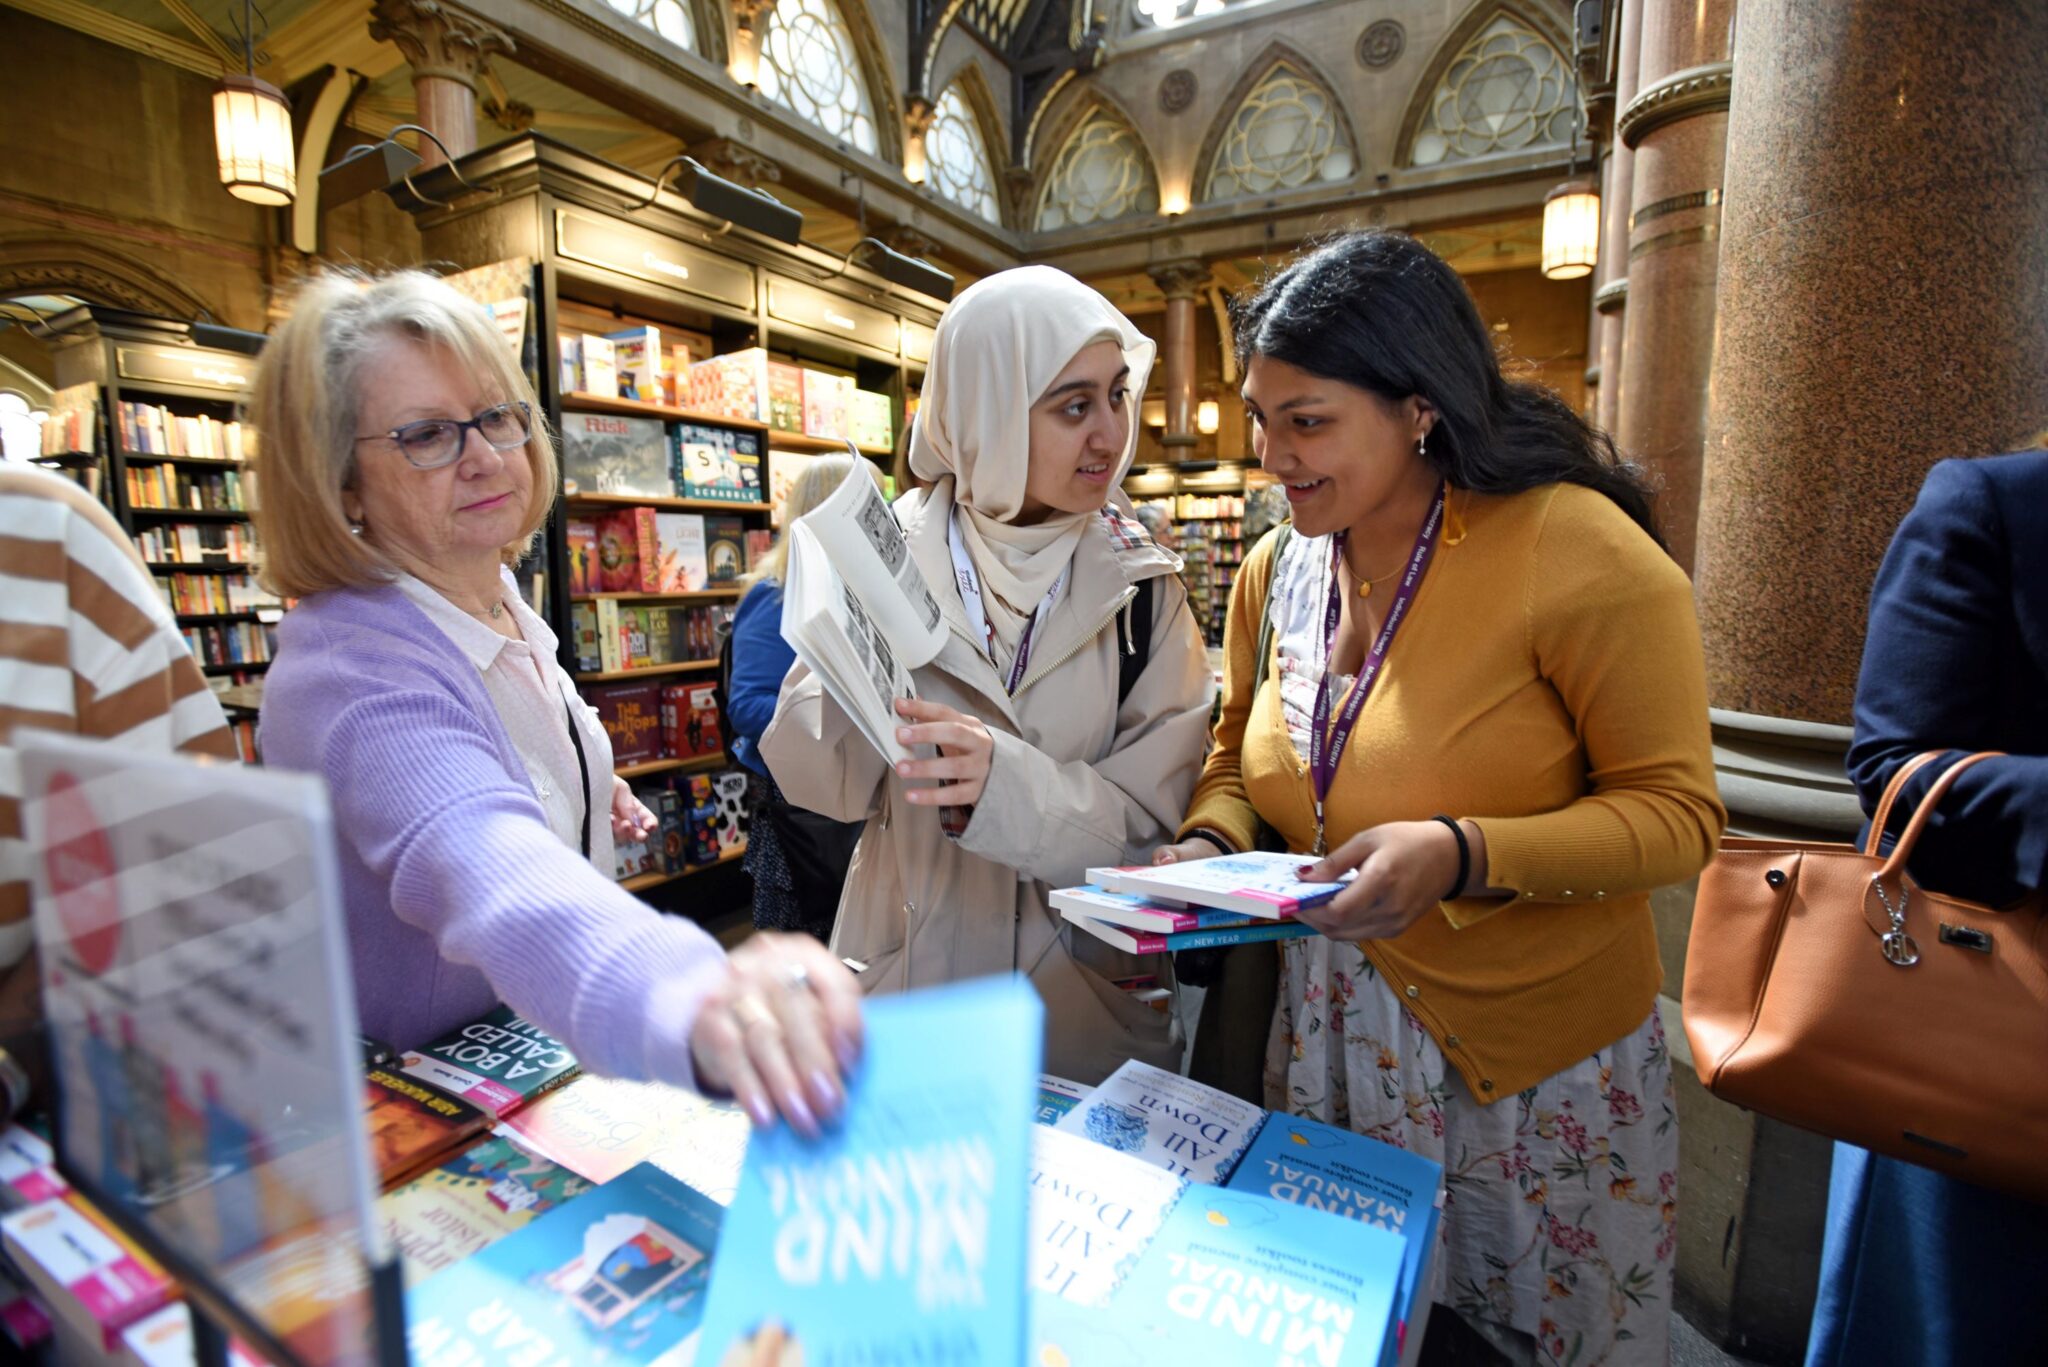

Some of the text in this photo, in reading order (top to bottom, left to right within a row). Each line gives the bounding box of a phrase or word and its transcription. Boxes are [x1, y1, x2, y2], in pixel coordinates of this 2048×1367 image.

[1422, 499, 1444, 540] Democracy
[1414, 546, 1426, 562] Rule
[1404, 571, 1416, 587] Law
[1373, 597, 1406, 656] Individual Liberty
[616, 702, 641, 716] THE
[1345, 666, 1375, 720] Mutual Respect
[1312, 729, 1321, 767] STUDENT
[1329, 730, 1346, 768] STUDENT
[1194, 937, 1215, 947] NEW
[1216, 935, 1240, 945] YEAR
[432, 1040, 540, 1079] A BOY
[462, 1024, 572, 1068] CALLED
[427, 1097, 462, 1116] ABIR
[1139, 1094, 1232, 1146] Down
[1163, 1132, 1218, 1161] All
[1167, 1159, 1193, 1177] It
[1279, 1152, 1410, 1208] Your complete mental
[1330, 1159, 1414, 1197] fitness toolkit
[1031, 1171, 1133, 1231] Down
[1265, 1159, 1407, 1226] MANUAL
[1046, 1219, 1114, 1259] All
[1045, 1261, 1078, 1297] It
[1187, 1242, 1358, 1303] Your complete mental
[1256, 1245, 1364, 1287] fitness toolkit
[1166, 1253, 1354, 1334] MANUAL
[466, 1297, 572, 1367] EAR
[1167, 1284, 1345, 1367] MIND
